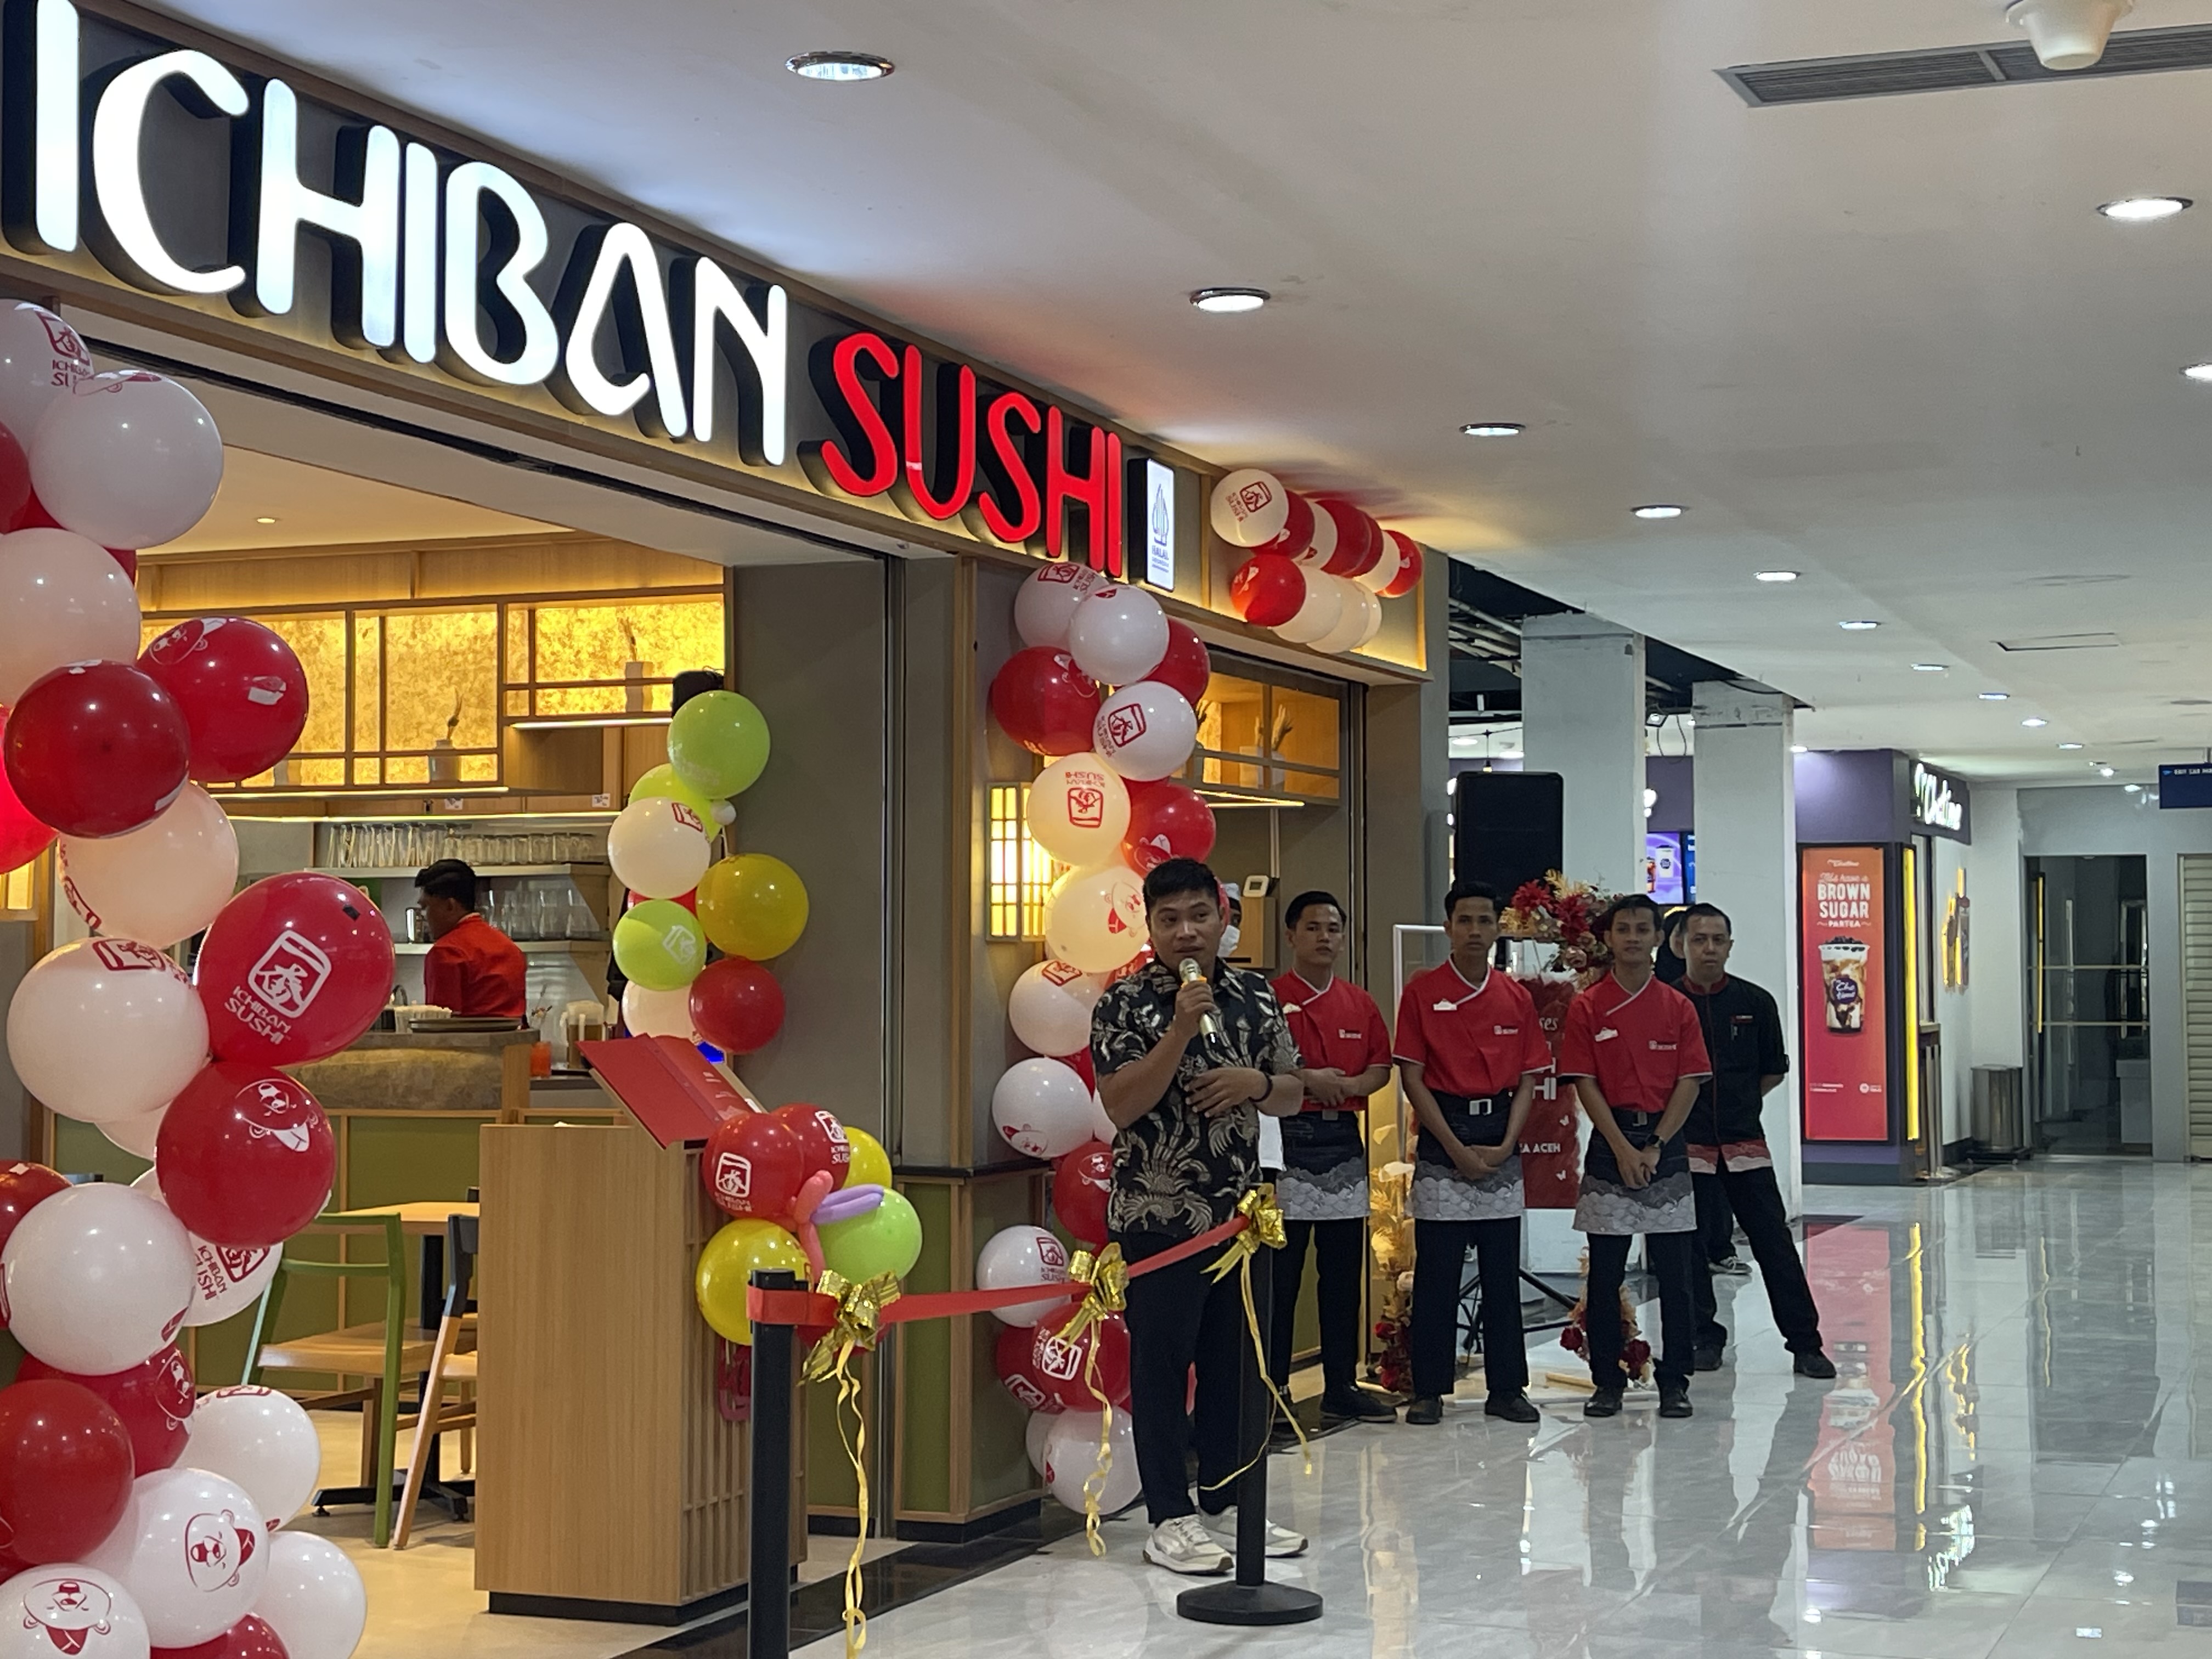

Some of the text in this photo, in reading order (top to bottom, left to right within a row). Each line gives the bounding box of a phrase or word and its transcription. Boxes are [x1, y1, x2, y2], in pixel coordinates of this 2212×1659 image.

[36, 0, 1122, 578] ICHIBAN SUSHI
[1818, 883, 1870, 900] BROWN
[1819, 901, 1869, 918] SUGAR
[224, 997, 284, 1045] SUSHI
[233, 985, 291, 1033] ICHIBAN
[1533, 1143, 1561, 1153] ACEH
[198, 1245, 228, 1294] ICHIBAN
